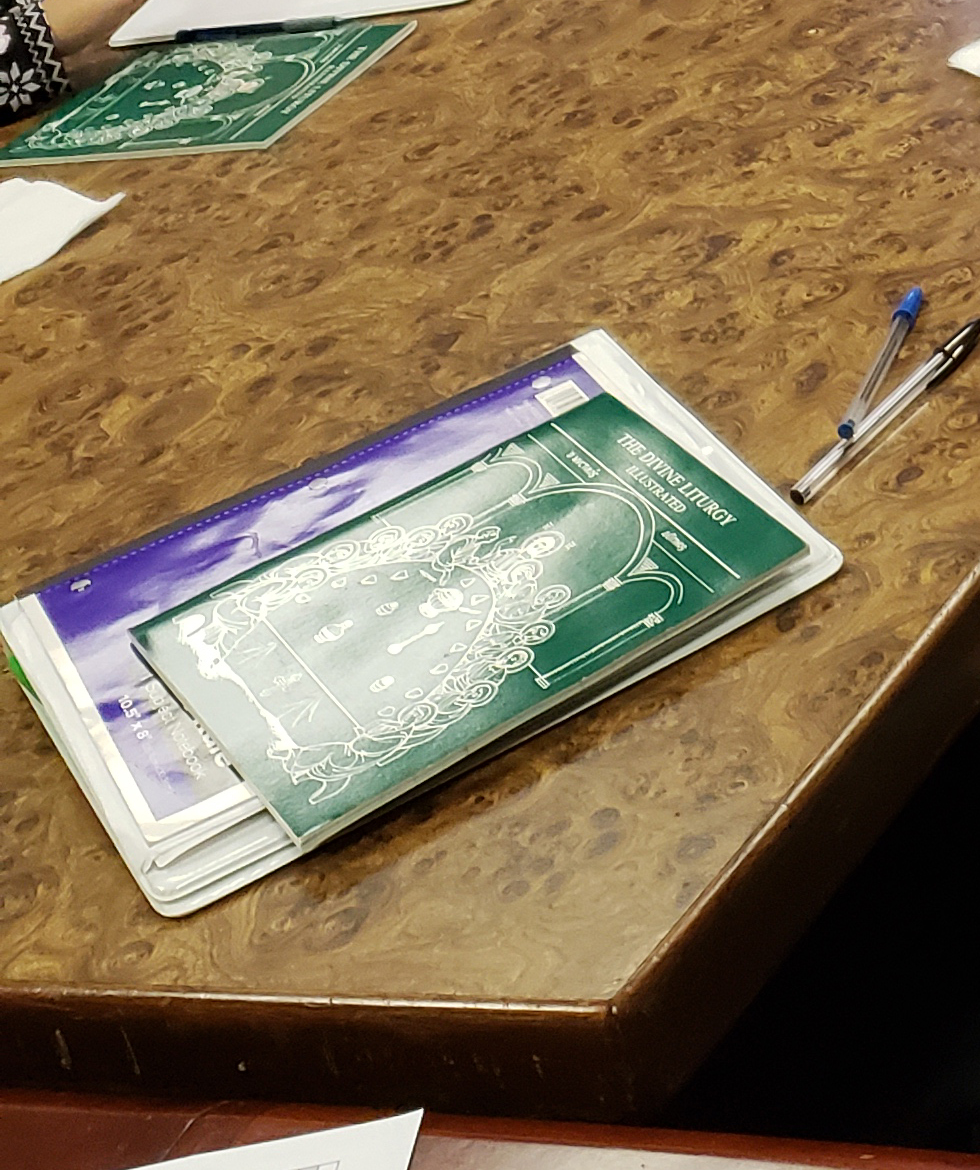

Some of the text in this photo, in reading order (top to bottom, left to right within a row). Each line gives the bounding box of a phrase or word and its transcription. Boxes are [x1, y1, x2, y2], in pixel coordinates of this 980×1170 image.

[617, 433, 646, 456] THE
[638, 451, 685, 487] DIVINE
[678, 482, 737, 526] LITURGY
[625, 465, 687, 514] ILLUSTRATED
